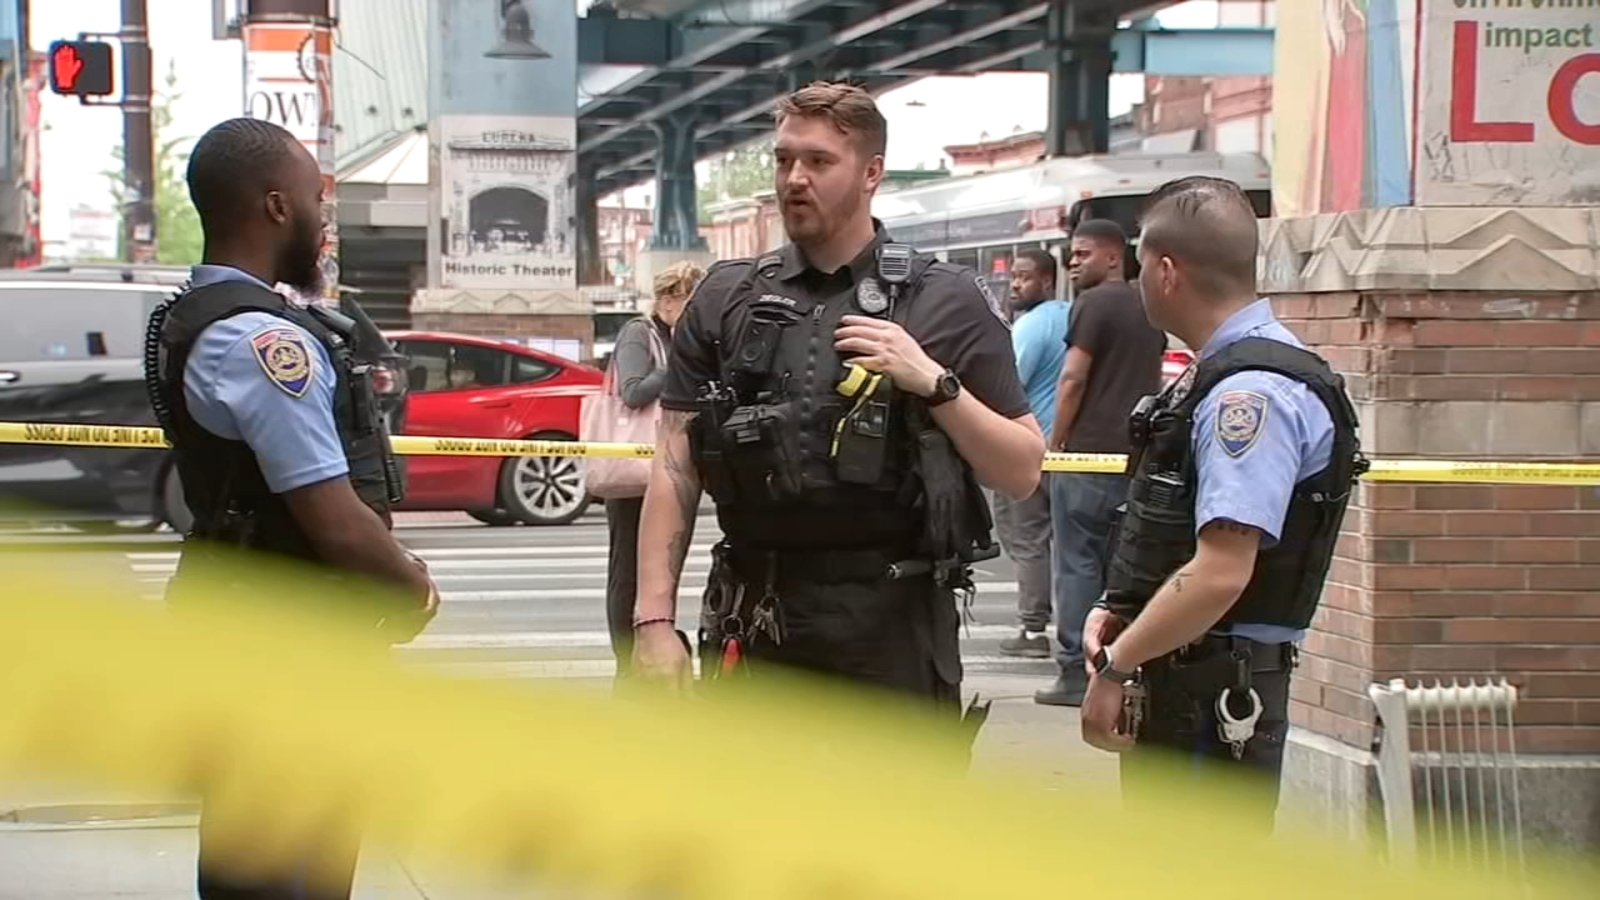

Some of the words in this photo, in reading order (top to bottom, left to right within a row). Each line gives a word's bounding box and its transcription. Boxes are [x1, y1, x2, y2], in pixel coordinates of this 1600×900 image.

[1485, 21, 1593, 54] impact
[445, 262, 507, 276] Historic
[513, 264, 574, 278] Theater
